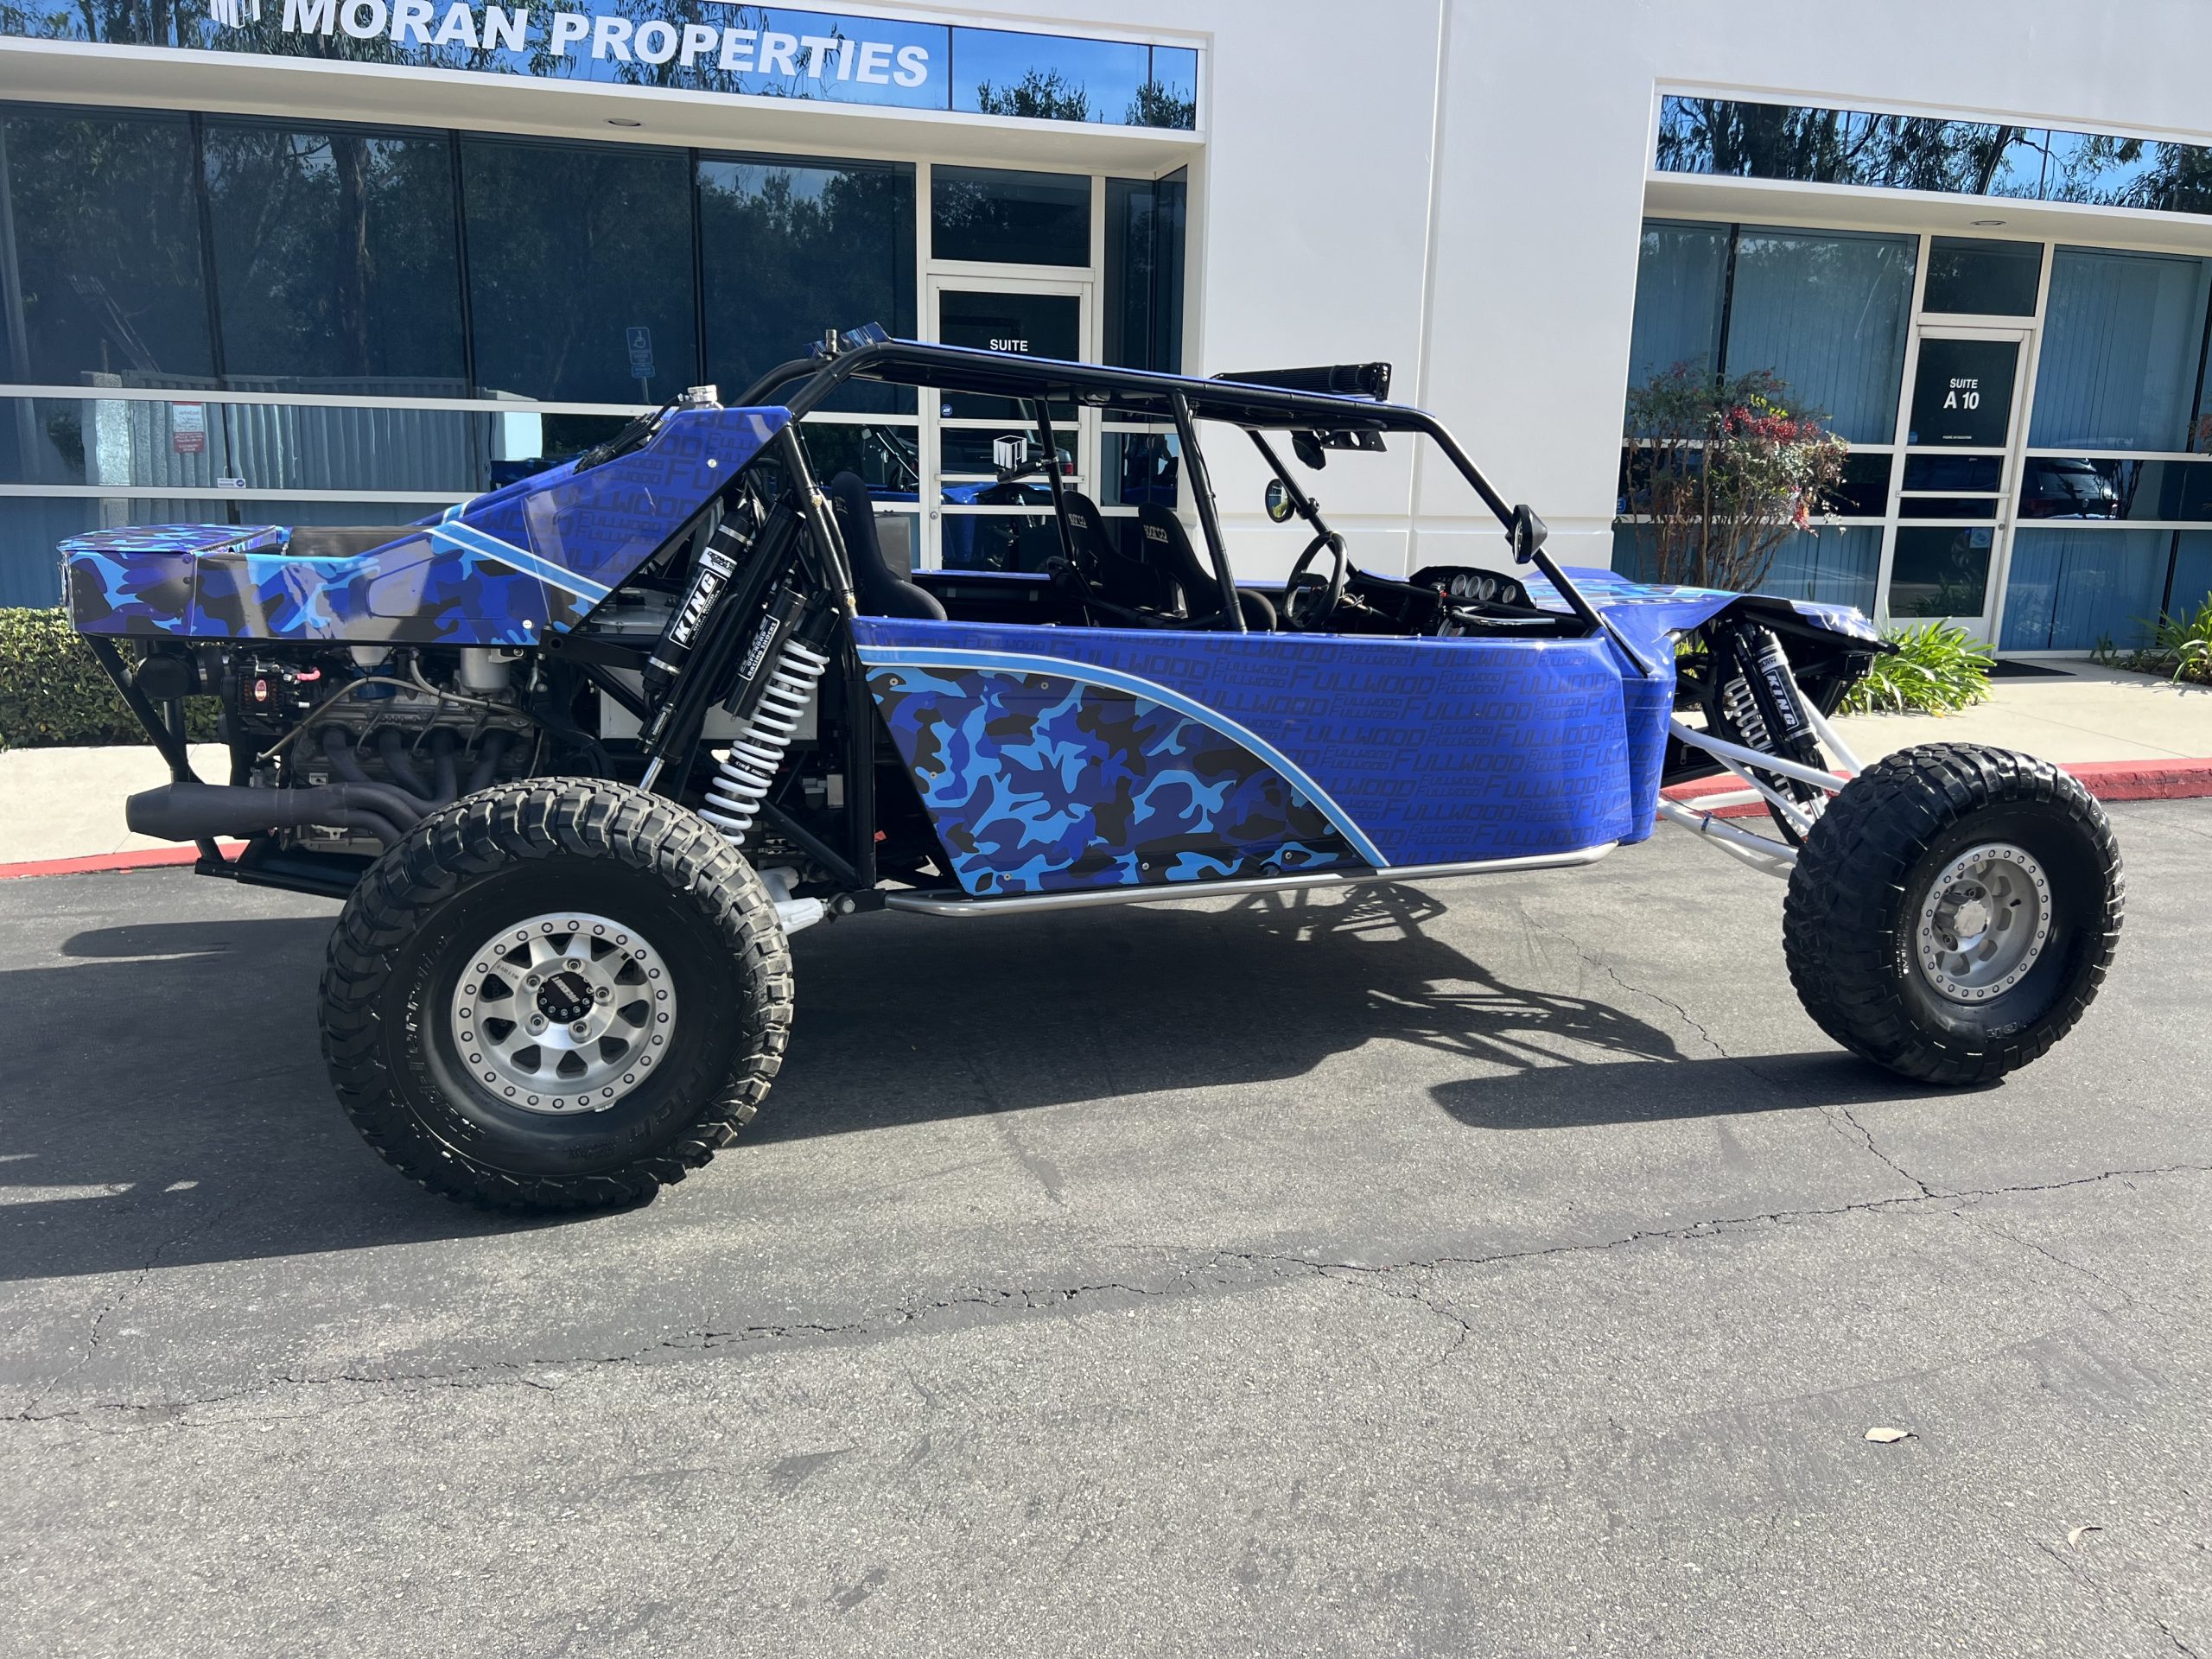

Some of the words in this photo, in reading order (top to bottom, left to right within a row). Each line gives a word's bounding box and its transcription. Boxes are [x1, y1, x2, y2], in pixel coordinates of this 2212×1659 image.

[282, 0, 529, 52] MORAN
[550, 12, 930, 88] PROPERTIES
[990, 339, 1028, 352] SUITE
[1943, 391, 1957, 409] A
[1962, 391, 1980, 410] 10
[1949, 378, 1978, 389] SUITE
[674, 573, 715, 644] KING
[747, 650, 763, 677] RACING
[760, 622, 777, 649] SHOCKS
[1766, 675, 1796, 725] KING
